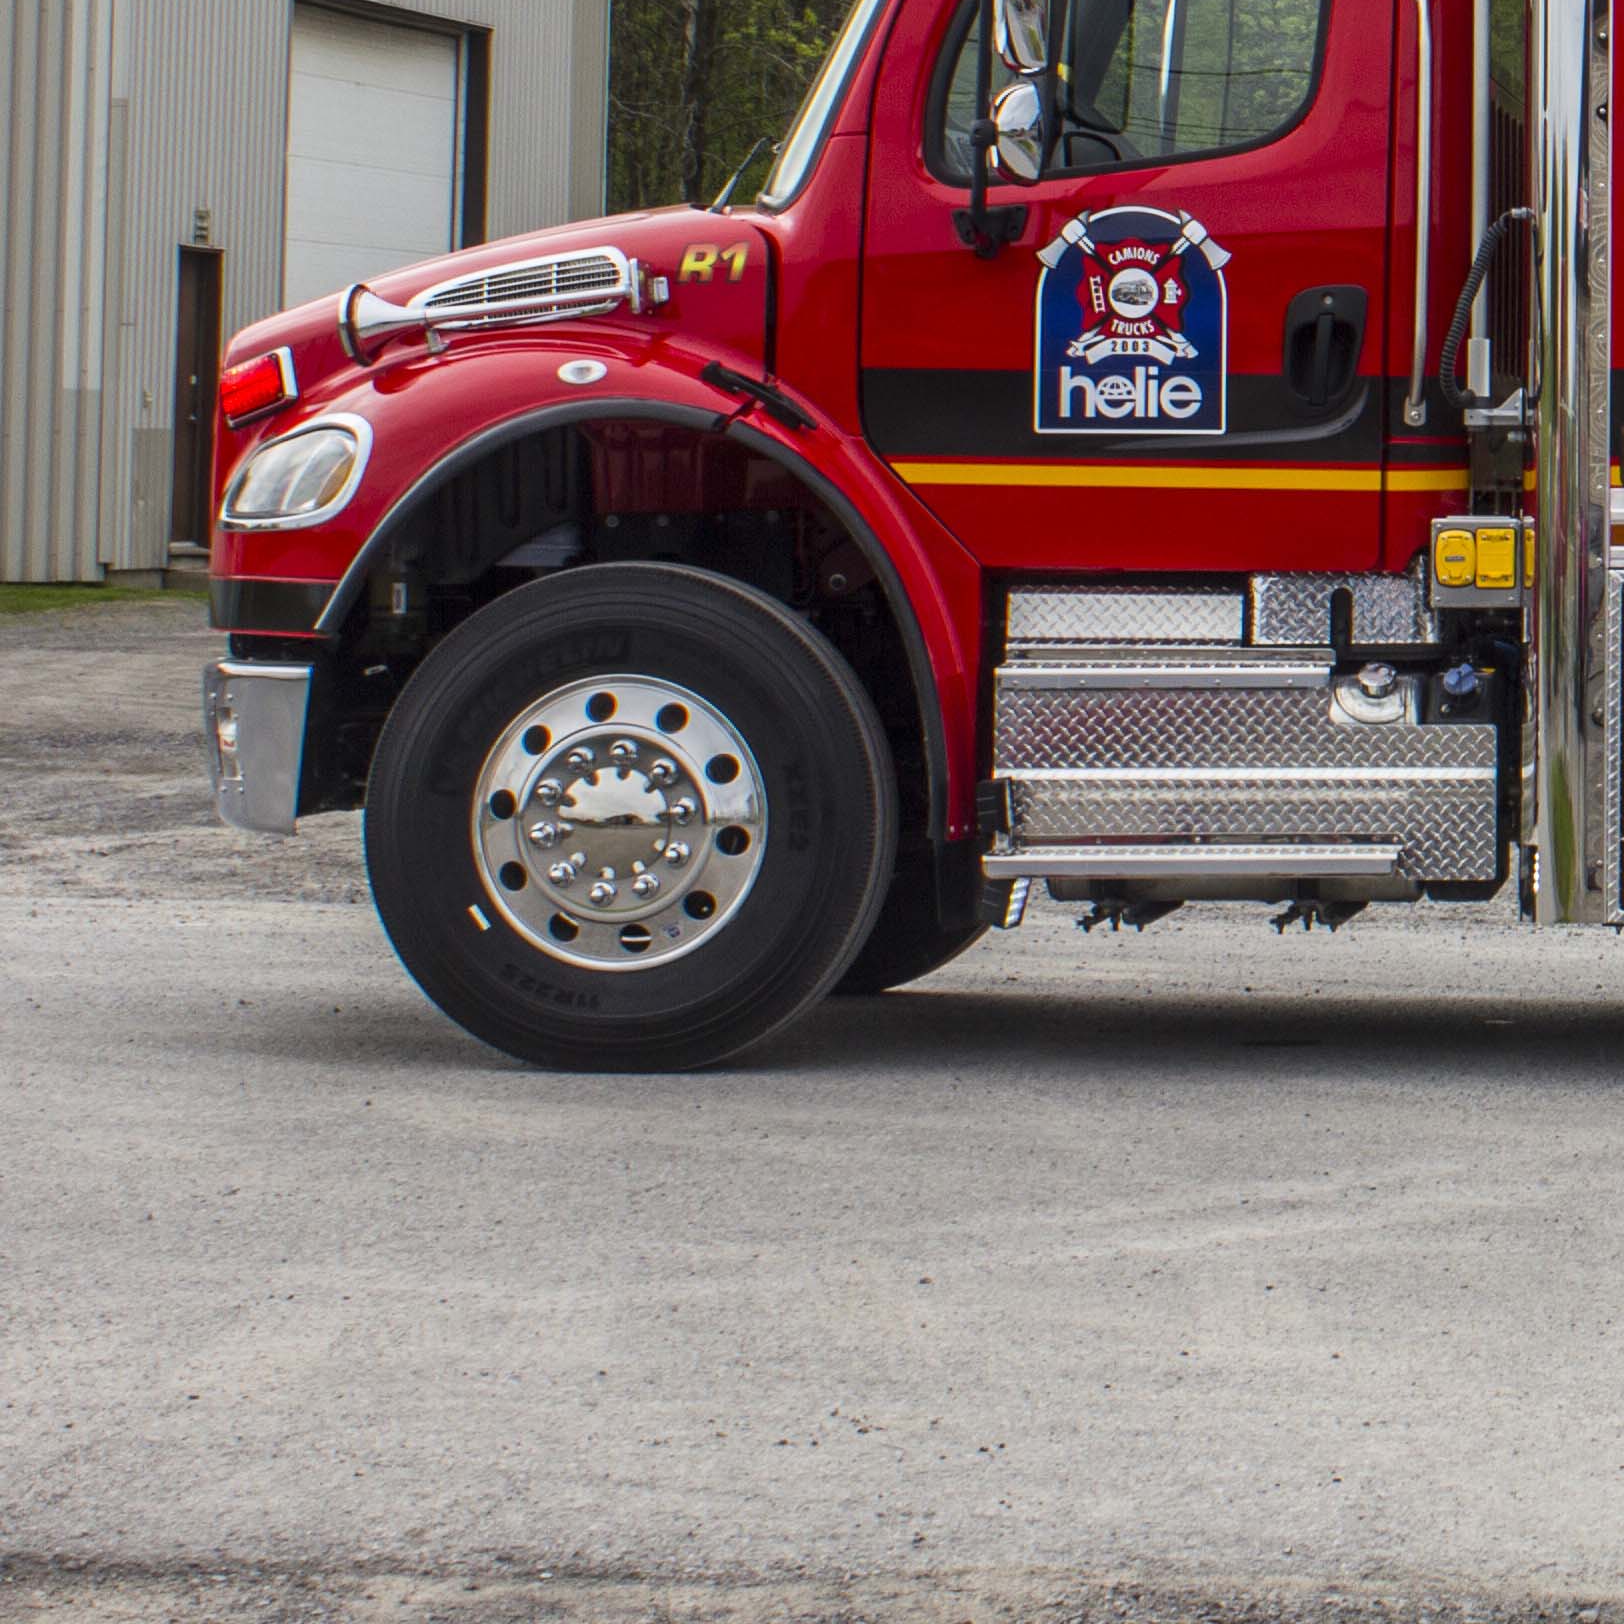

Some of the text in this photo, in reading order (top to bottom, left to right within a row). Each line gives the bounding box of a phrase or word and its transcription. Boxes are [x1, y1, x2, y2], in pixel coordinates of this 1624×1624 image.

[675, 241, 750, 284] R1
[1108, 246, 1161, 265] CAMIONS
[1111, 319, 1155, 336] TRUCKS
[1111, 340, 1151, 353] 2003
[1059, 366, 1202, 418] helie
